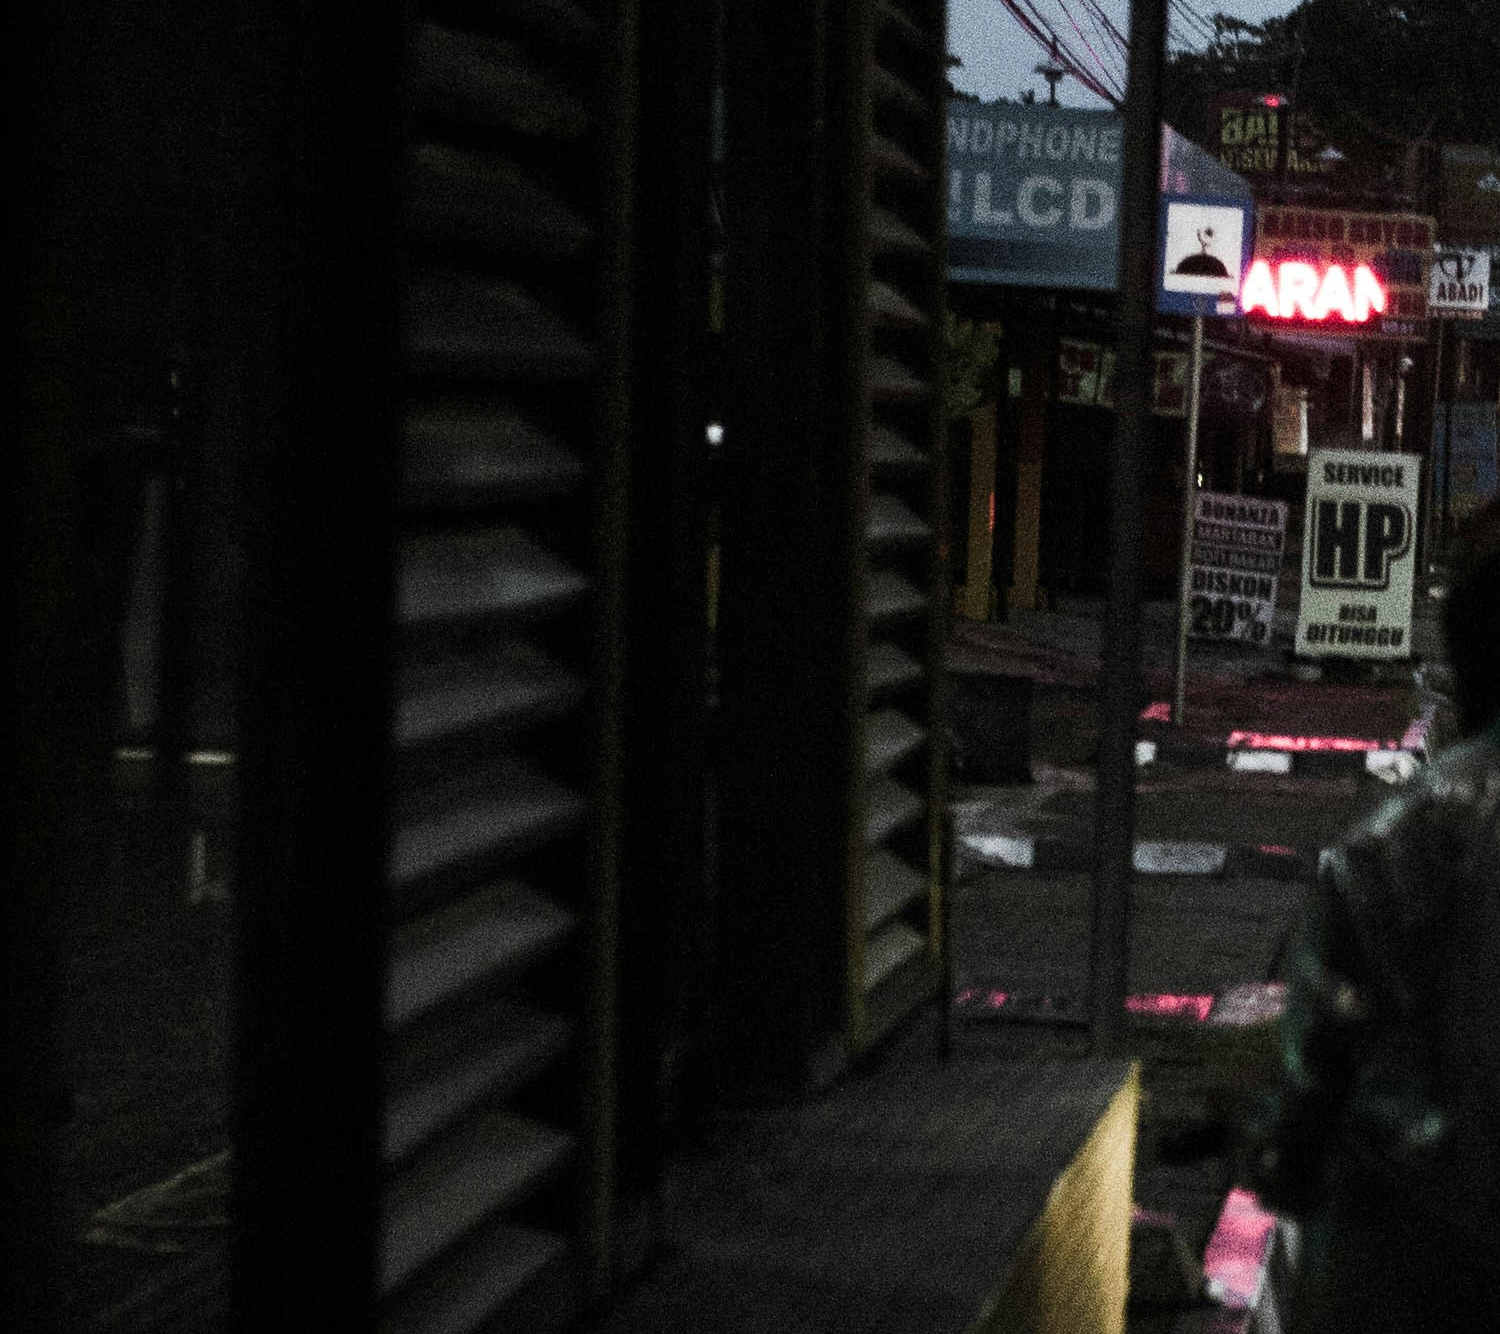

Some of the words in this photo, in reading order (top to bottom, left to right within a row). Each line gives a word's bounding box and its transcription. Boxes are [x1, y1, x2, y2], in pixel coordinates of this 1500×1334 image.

[1436, 282, 1484, 303] ABADI
[1324, 463, 1404, 487] SERVICE
[1202, 500, 1280, 525] BONANZA
[1314, 499, 1408, 584] HP
[1192, 569, 1272, 600] DISKON
[1190, 594, 1267, 641] 20%
[1339, 604, 1377, 623] BISA
[1306, 623, 1404, 646] DITUNGGU
